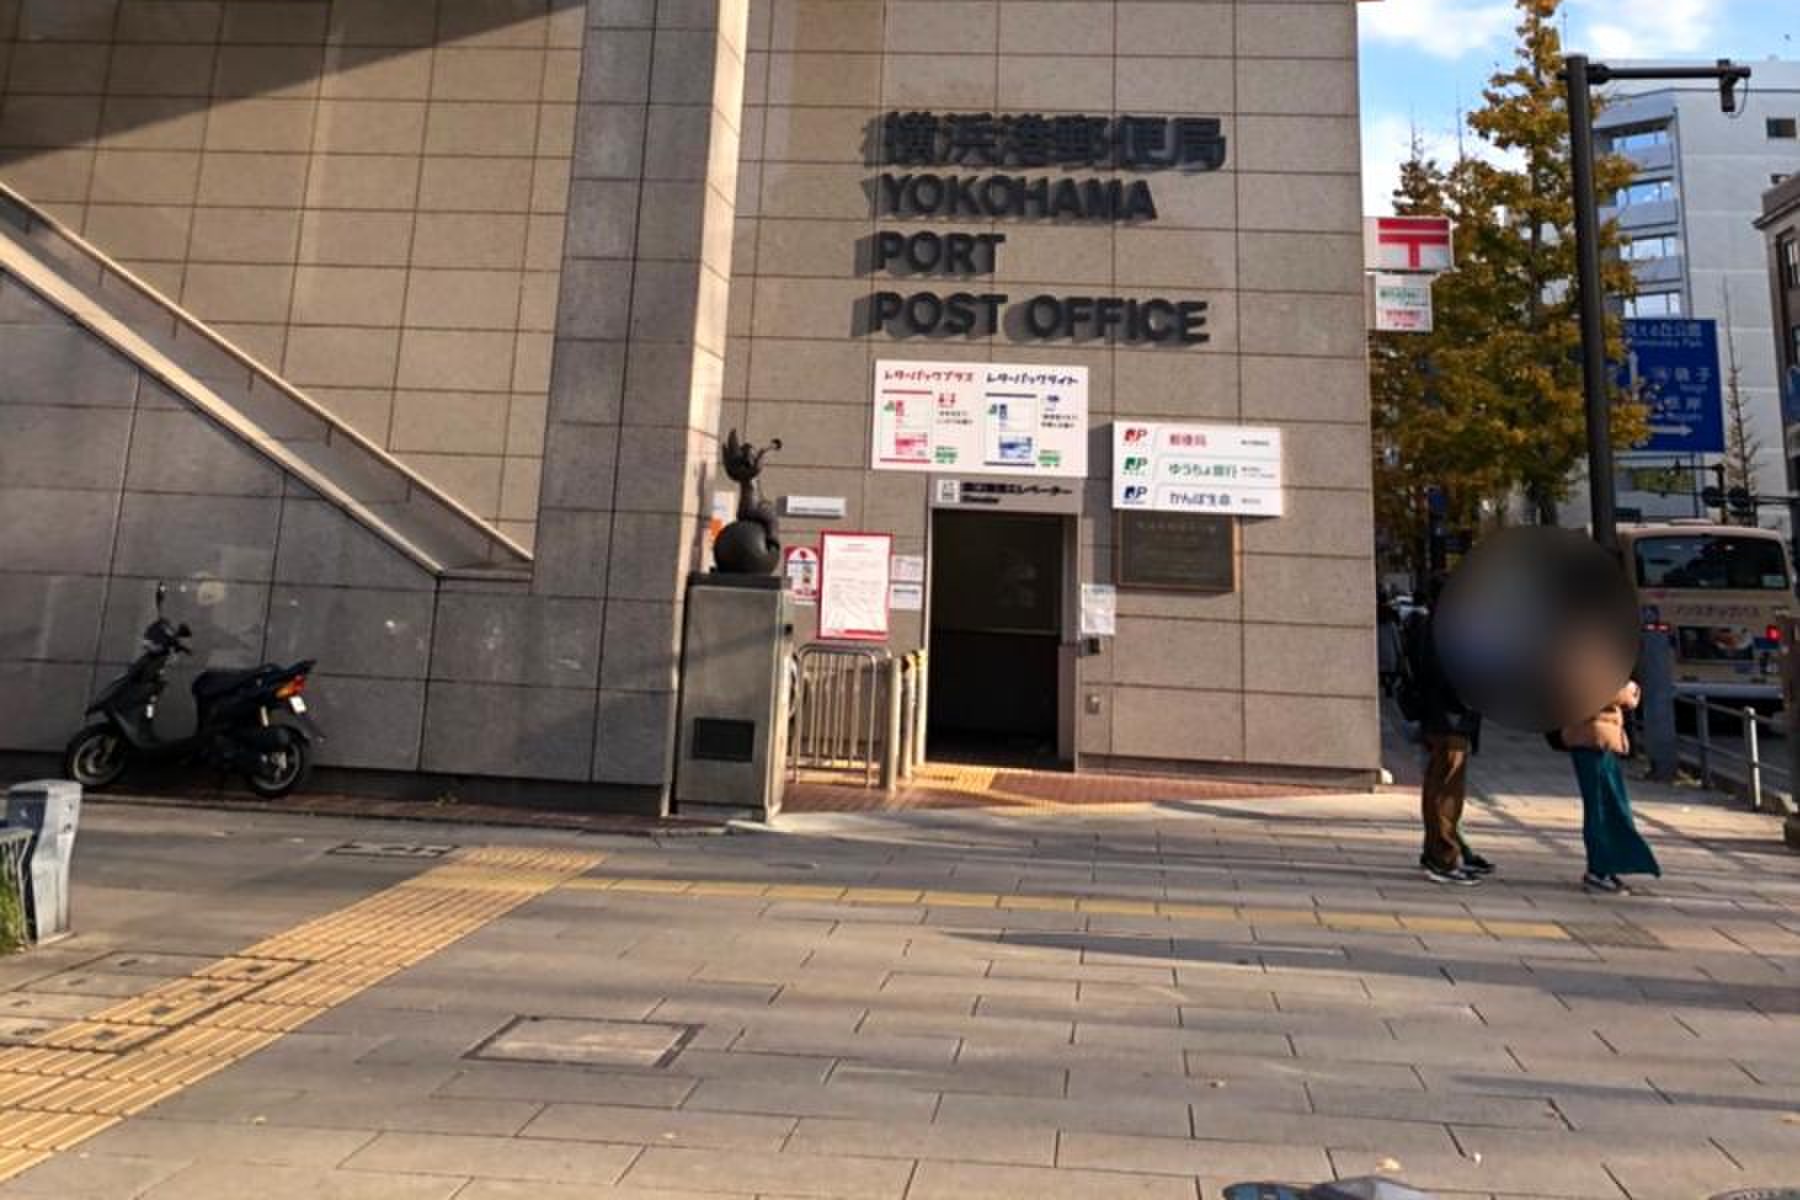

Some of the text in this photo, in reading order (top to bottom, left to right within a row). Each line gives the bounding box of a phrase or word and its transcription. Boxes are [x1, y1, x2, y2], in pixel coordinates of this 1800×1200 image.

[880, 173, 1158, 220] YOKOHAMA
[877, 231, 1006, 275] PORT
[872, 292, 1210, 343] POST OFFICE
